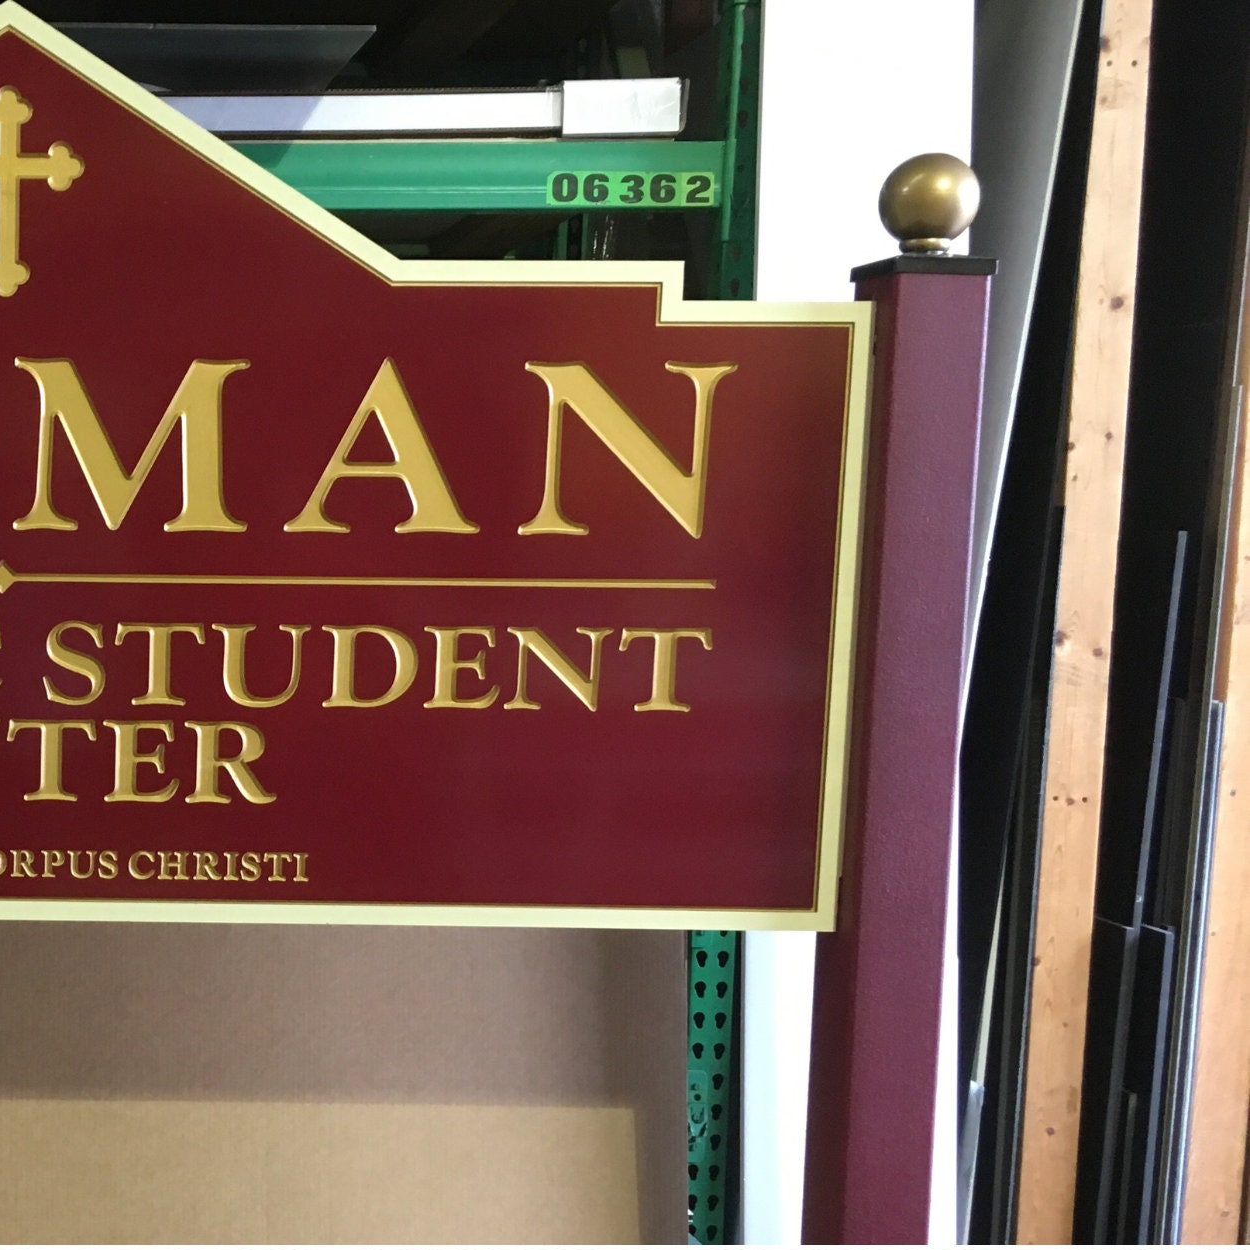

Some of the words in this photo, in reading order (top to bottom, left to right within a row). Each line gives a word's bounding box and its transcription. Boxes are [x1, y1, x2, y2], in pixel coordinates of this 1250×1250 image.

[552, 172, 712, 204] 06362
[42, 621, 713, 713] STUDENT
[127, 850, 310, 884] CHRISTI
